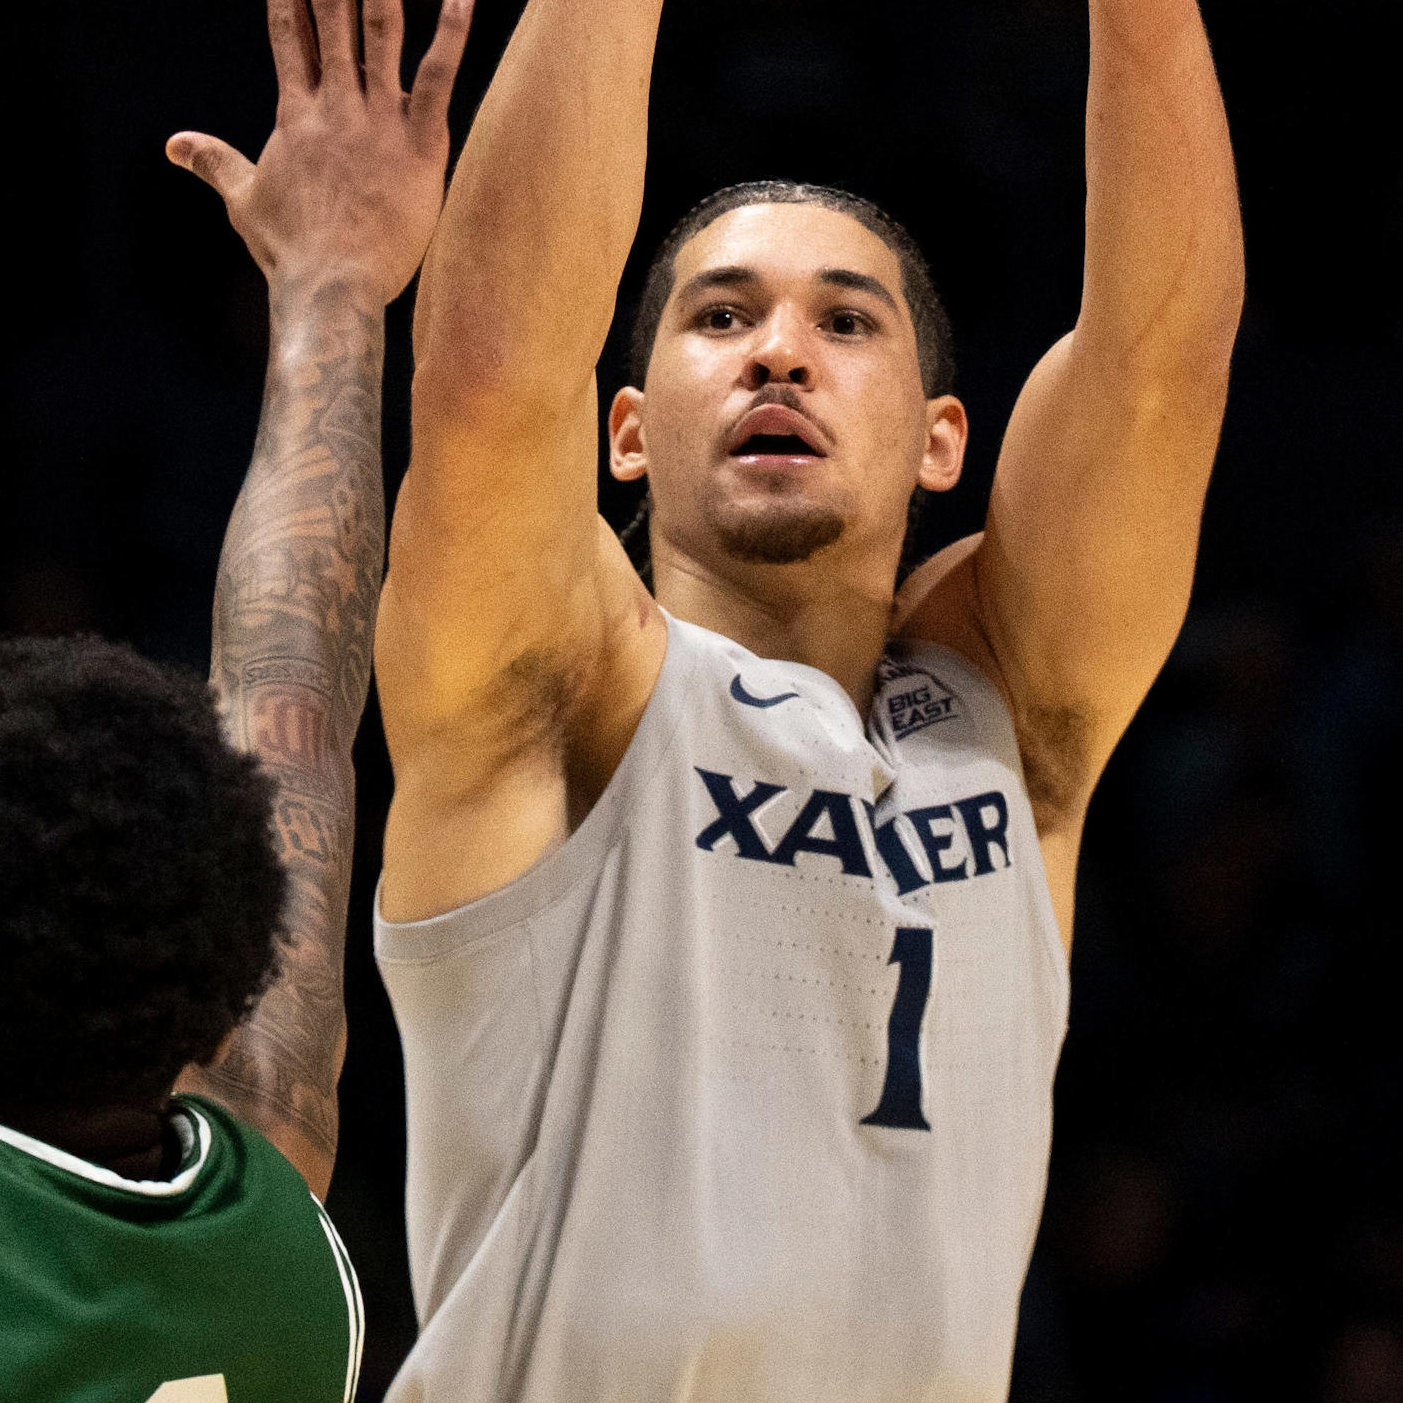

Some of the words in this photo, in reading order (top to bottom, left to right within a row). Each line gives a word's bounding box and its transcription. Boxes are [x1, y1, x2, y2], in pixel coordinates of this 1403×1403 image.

[889, 686, 931, 714] BIG
[892, 697, 954, 732] EAST
[859, 927, 933, 1131] 1
